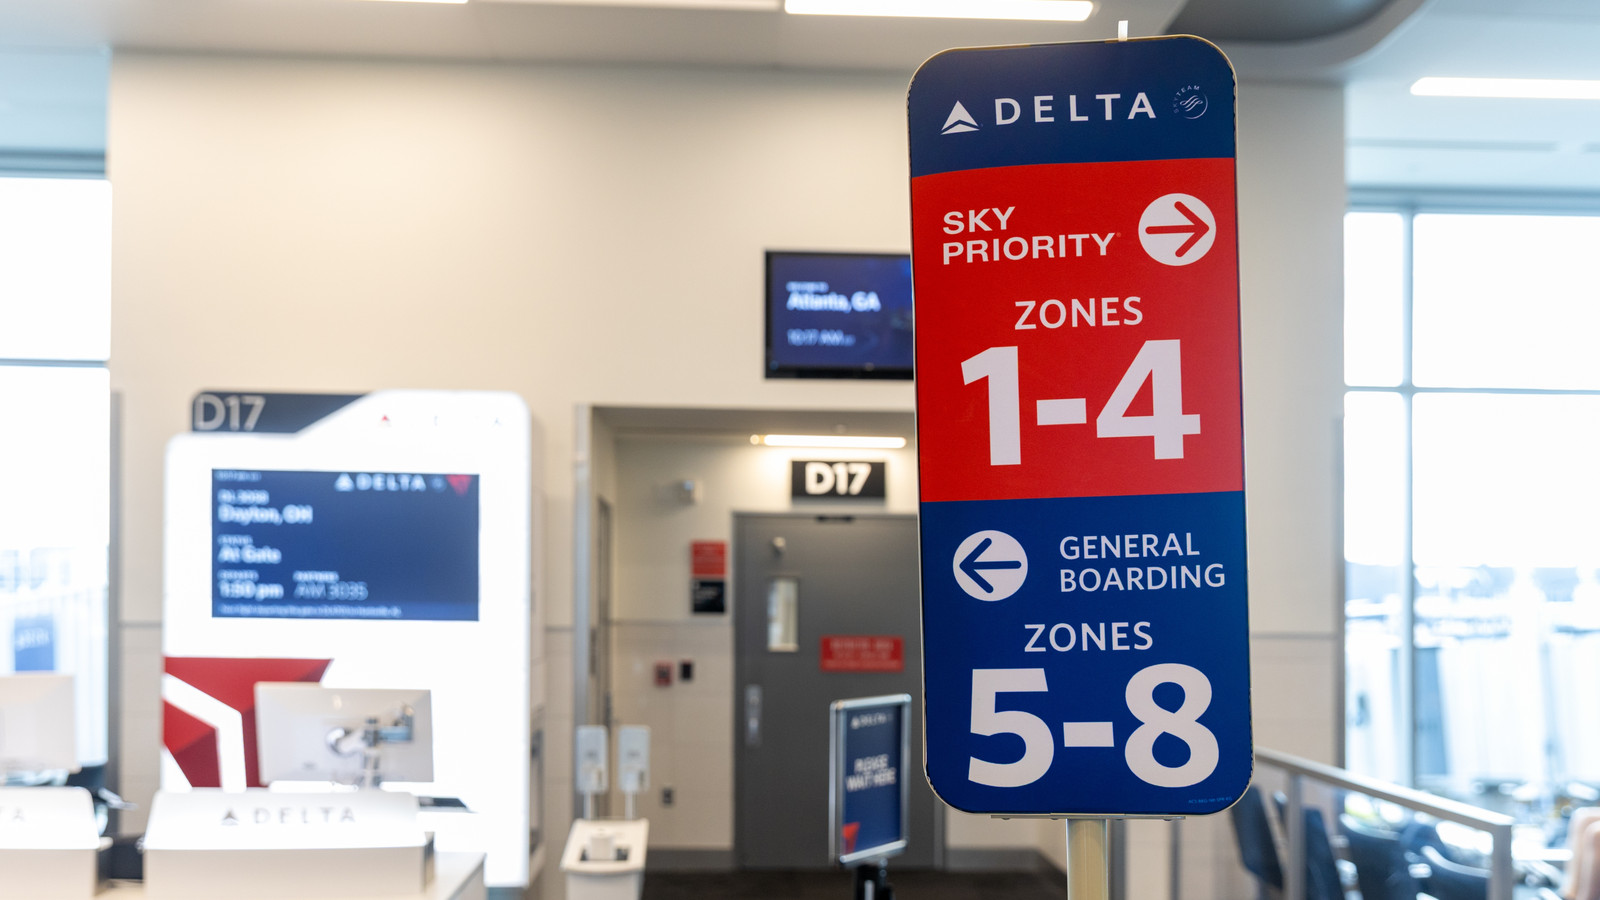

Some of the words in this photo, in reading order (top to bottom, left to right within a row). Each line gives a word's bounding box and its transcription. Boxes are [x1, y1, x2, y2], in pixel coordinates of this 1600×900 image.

[995, 92, 1157, 125] DELTA
[1173, 85, 1200, 114] SKYTEAM
[943, 206, 1016, 235] SKY
[943, 233, 1115, 265] PRIORITY
[786, 291, 851, 314] Atlanta,
[851, 291, 882, 313] GA
[1014, 296, 1143, 330] ZONES
[196, 395, 266, 430] D17
[961, 339, 1201, 466] 1-4
[356, 473, 427, 491] DELTA
[805, 461, 872, 495] D17
[1059, 532, 1200, 560] GENERAL
[1060, 563, 1225, 592] BOARDING
[1023, 621, 1153, 652] ZONES
[968, 663, 1220, 789] 5-8
[252, 806, 356, 825] DELTA
